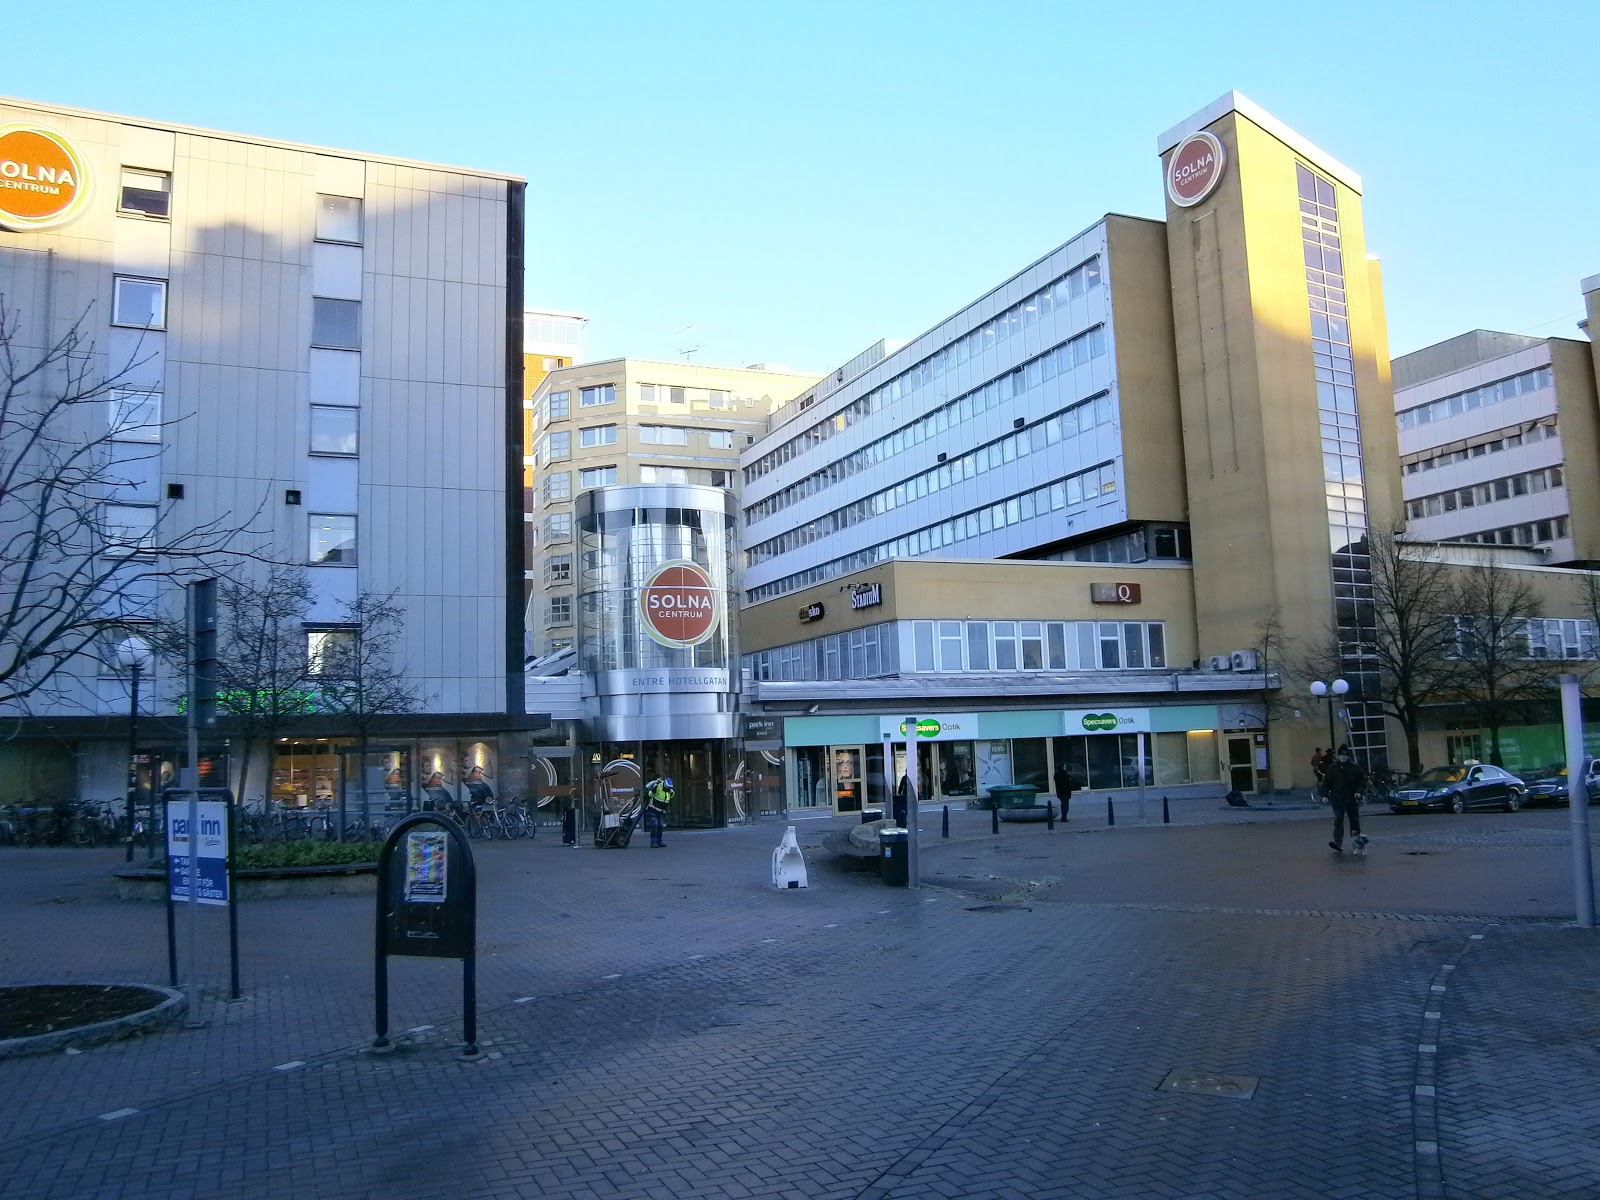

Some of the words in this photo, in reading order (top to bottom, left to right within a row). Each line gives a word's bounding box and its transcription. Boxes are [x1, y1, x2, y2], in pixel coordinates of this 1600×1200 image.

[1175, 153, 1213, 182] SOLNA
[1180, 167, 1208, 186] CENTRUM
[649, 594, 712, 609] SOLNA
[851, 583, 880, 609] STADIUM
[658, 610, 703, 618] CENTRUM
[632, 677, 664, 687] ENTRE
[668, 676, 728, 686] HOTELLGATAN
[749, 721, 763, 729] park
[901, 724, 940, 732] Scsavers
[942, 723, 961, 731] Optik
[1083, 718, 1117, 726] Specsavers
[1118, 717, 1135, 725] Optik
[201, 814, 221, 836] inn
